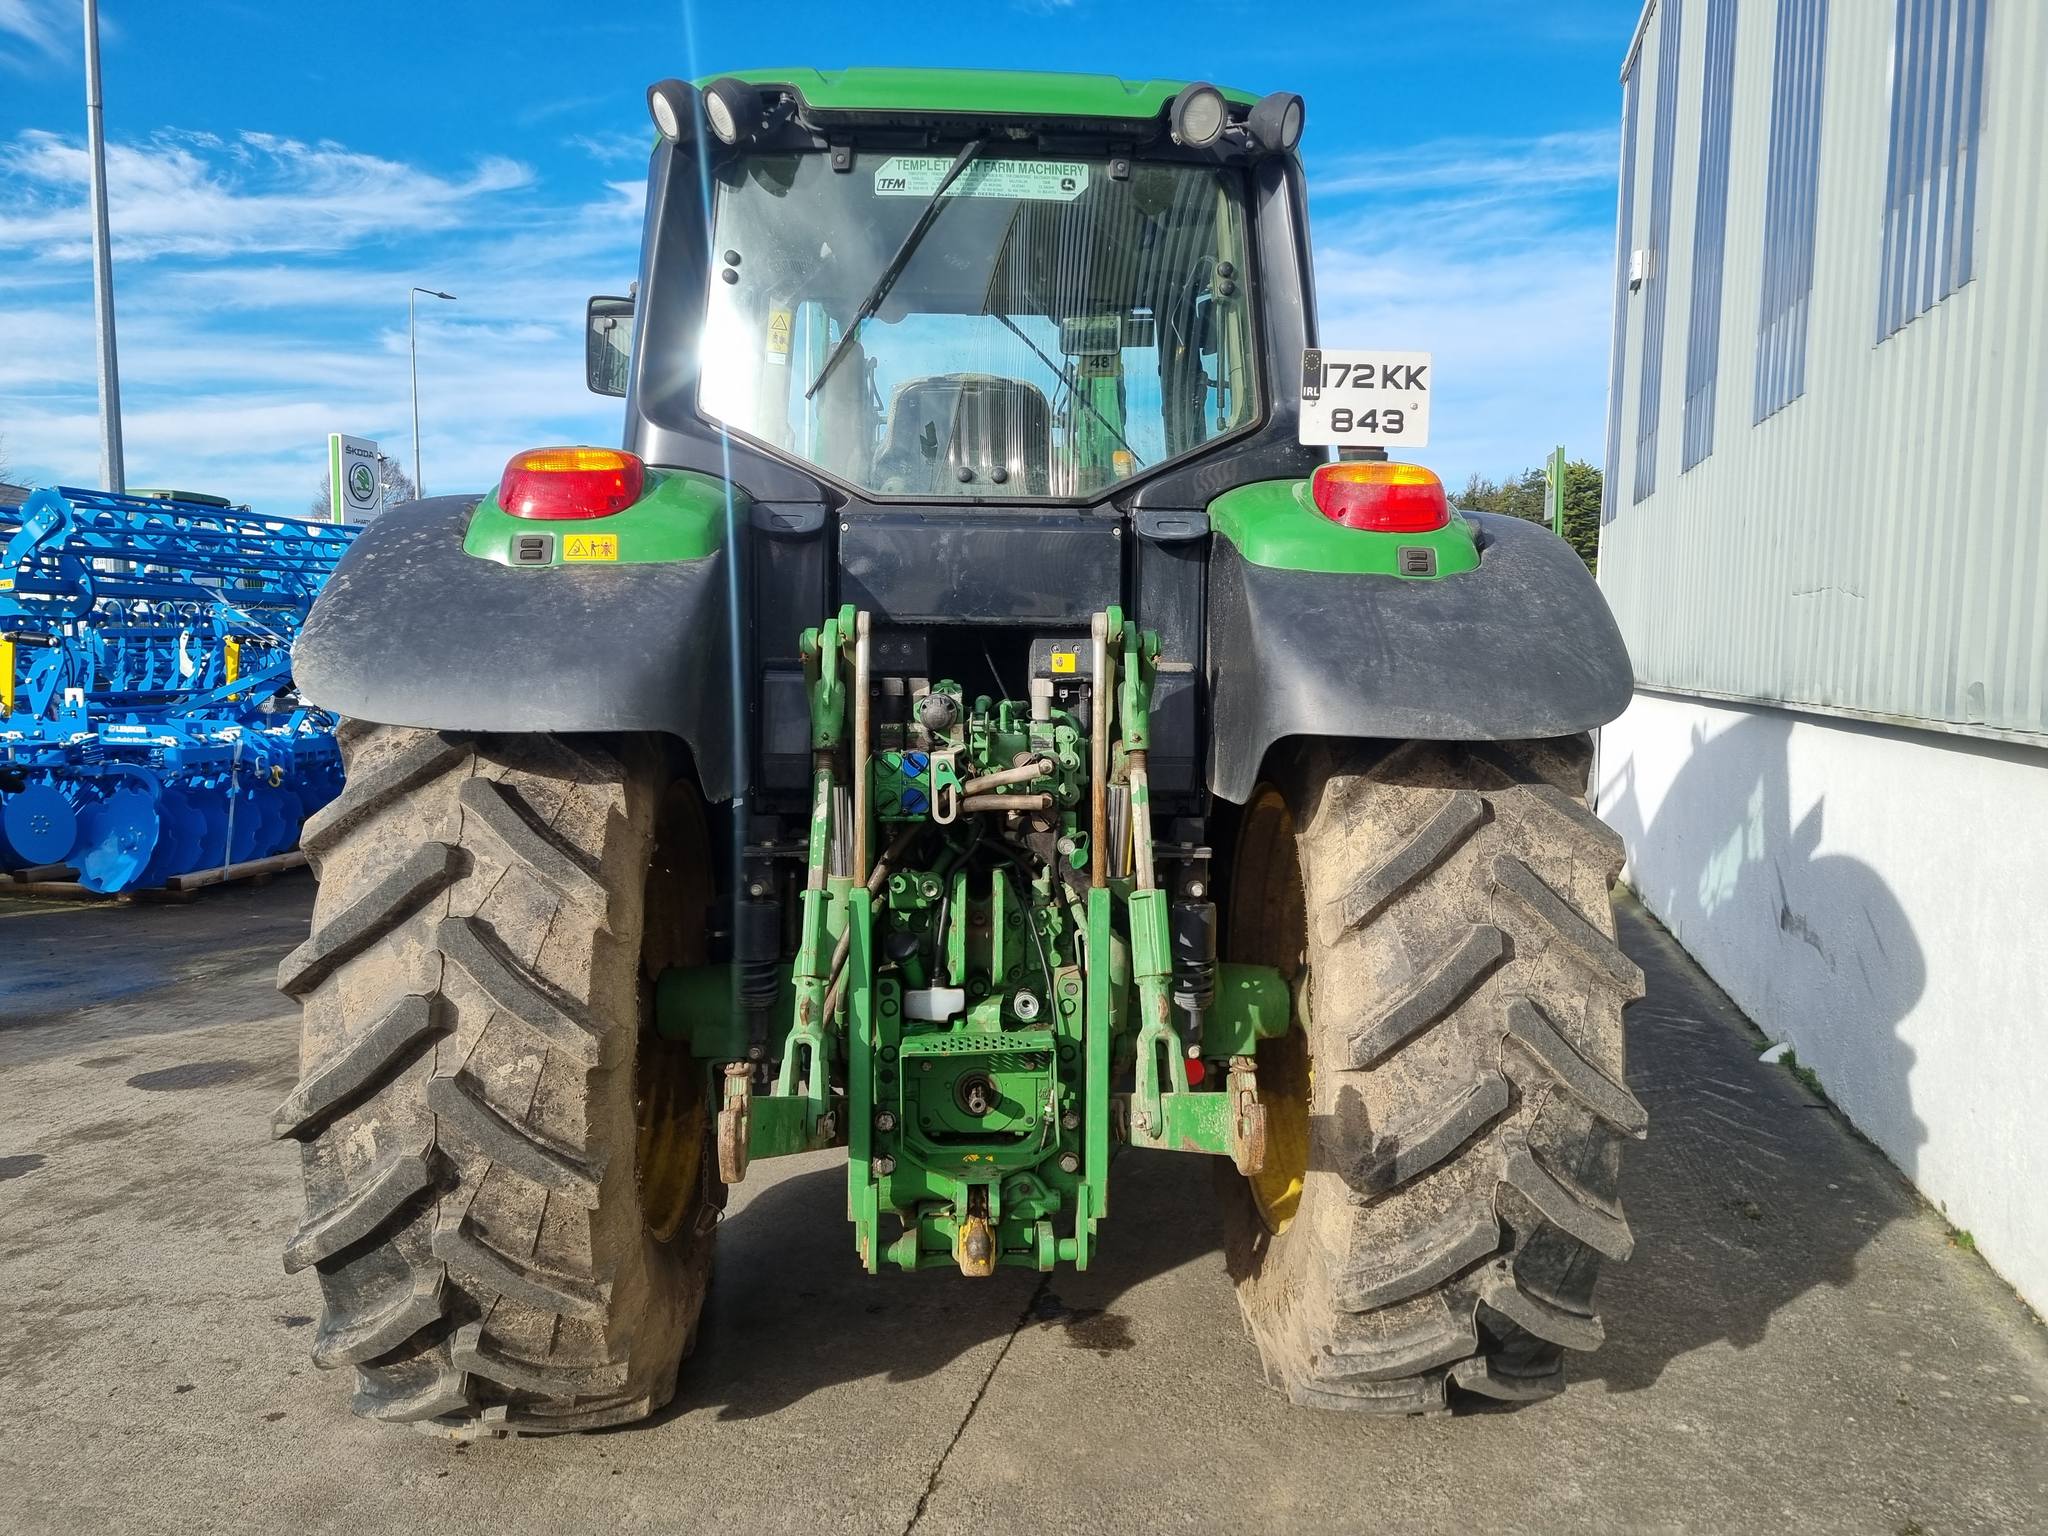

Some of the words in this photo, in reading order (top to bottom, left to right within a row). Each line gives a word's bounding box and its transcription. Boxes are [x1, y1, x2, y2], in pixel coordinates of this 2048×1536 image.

[984, 161, 1015, 173] FARM
[1019, 163, 1085, 176] MACHINERY
[881, 179, 905, 188] TFM
[1090, 357, 1109, 368] 48
[1322, 363, 1375, 388] 172
[1381, 364, 1428, 390] KK
[1302, 386, 1320, 396] IRL
[1331, 408, 1404, 434] 843
